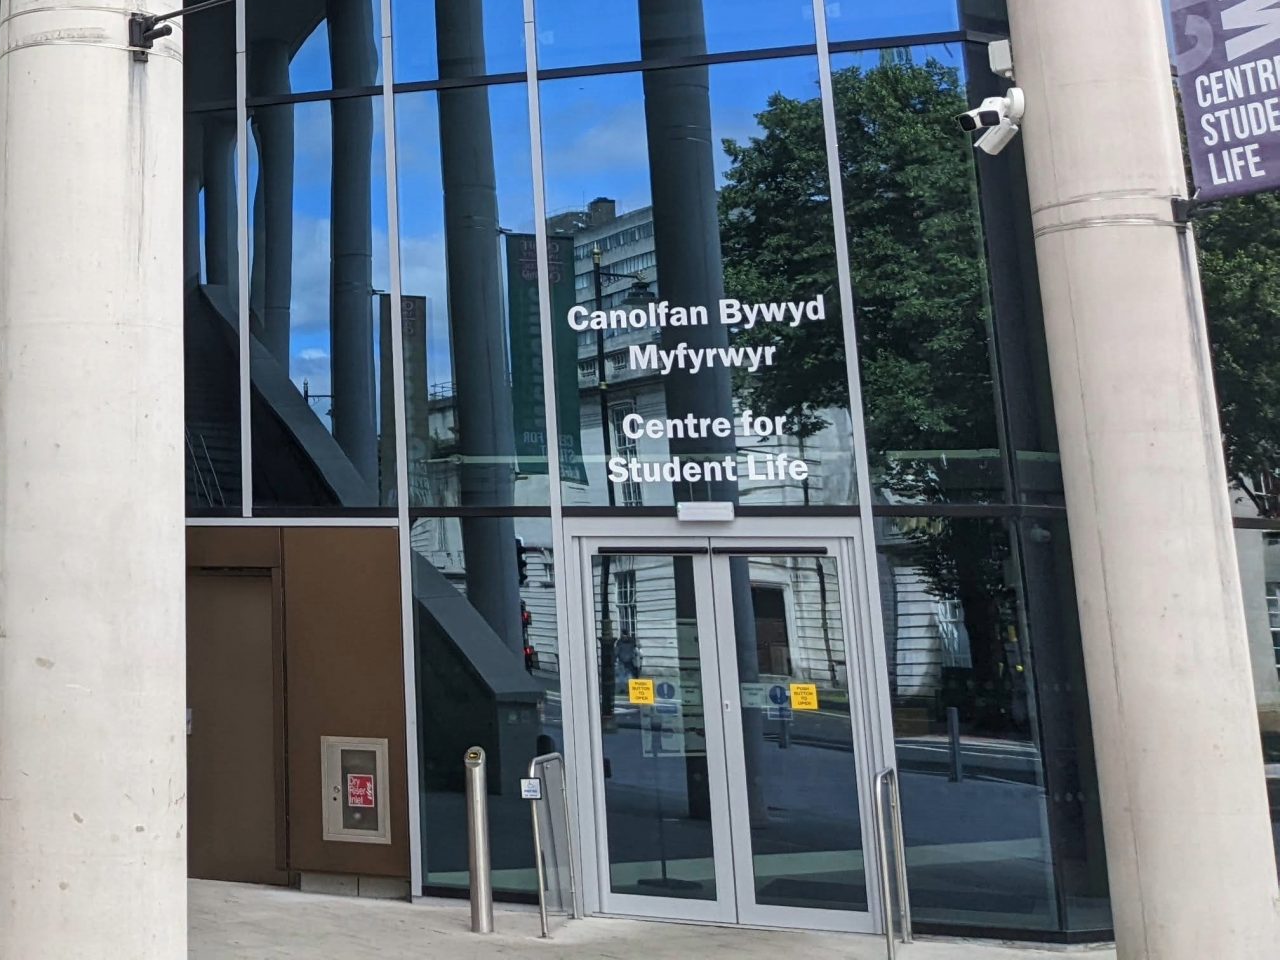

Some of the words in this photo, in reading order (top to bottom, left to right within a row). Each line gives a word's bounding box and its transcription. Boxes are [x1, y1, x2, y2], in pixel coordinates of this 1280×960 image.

[1208, 143, 1266, 185] LIFE
[567, 300, 708, 331] Canolfan
[719, 294, 825, 329] Bywyd
[629, 342, 776, 375] Myfyrwyr
[622, 413, 731, 439] Centre
[741, 410, 786, 436] for
[608, 455, 737, 483] Student
[747, 454, 808, 481] Life
